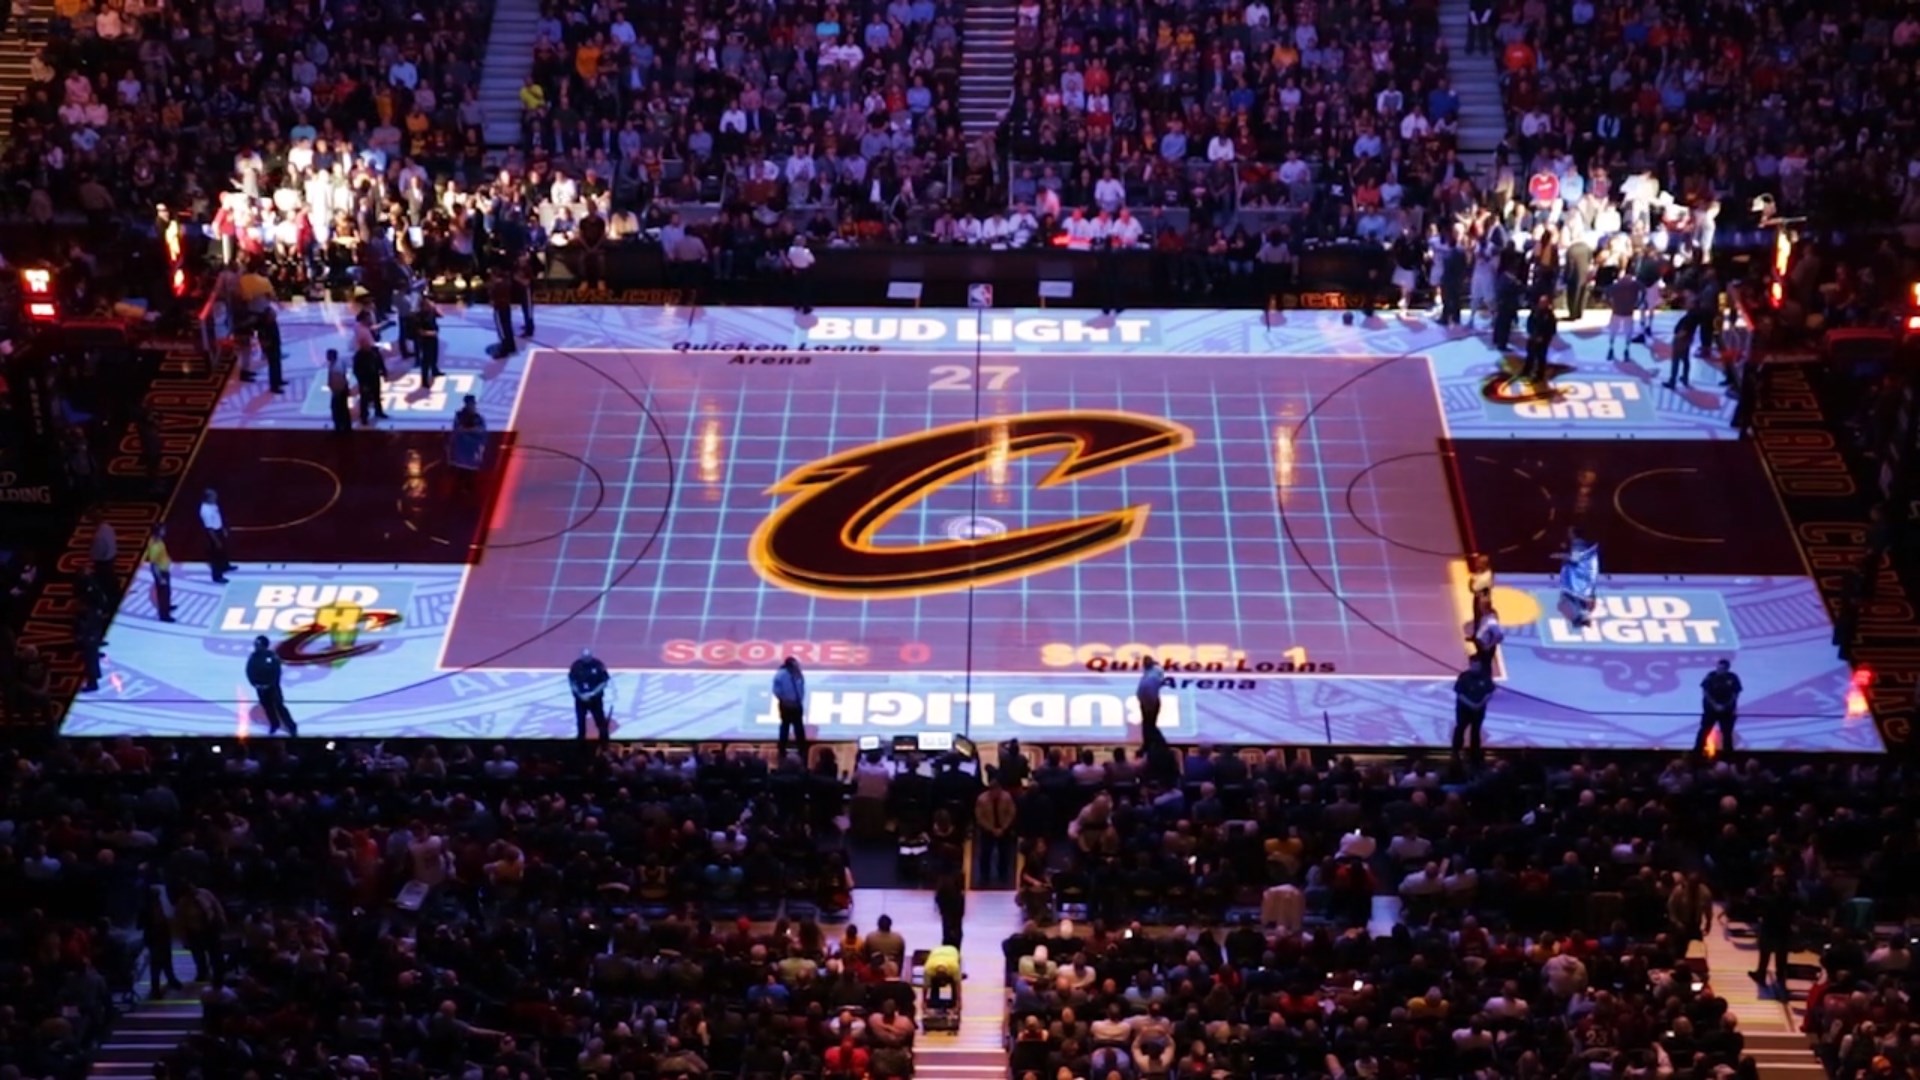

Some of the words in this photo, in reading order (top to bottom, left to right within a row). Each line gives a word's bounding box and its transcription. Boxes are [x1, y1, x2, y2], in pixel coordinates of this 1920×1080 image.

[808, 317, 946, 341] BUD
[955, 319, 1150, 342] LIGHT
[672, 341, 788, 353] Quicken
[796, 342, 881, 353] Loans
[728, 354, 813, 365] Arena
[927, 364, 1021, 391] 27
[1513, 400, 1626, 419] BUD
[254, 584, 380, 608] BUD
[220, 606, 398, 632] LIGHT
[1549, 618, 1720, 643] LIGHT
[660, 639, 870, 666] SCORE:
[901, 642, 932, 664] 0
[1283, 646, 1308, 667] 1
[1085, 657, 1224, 673] Quiken
[1236, 659, 1336, 673] Loans
[1160, 676, 1257, 690] Arena
[1016, 693, 1180, 727] BUD
